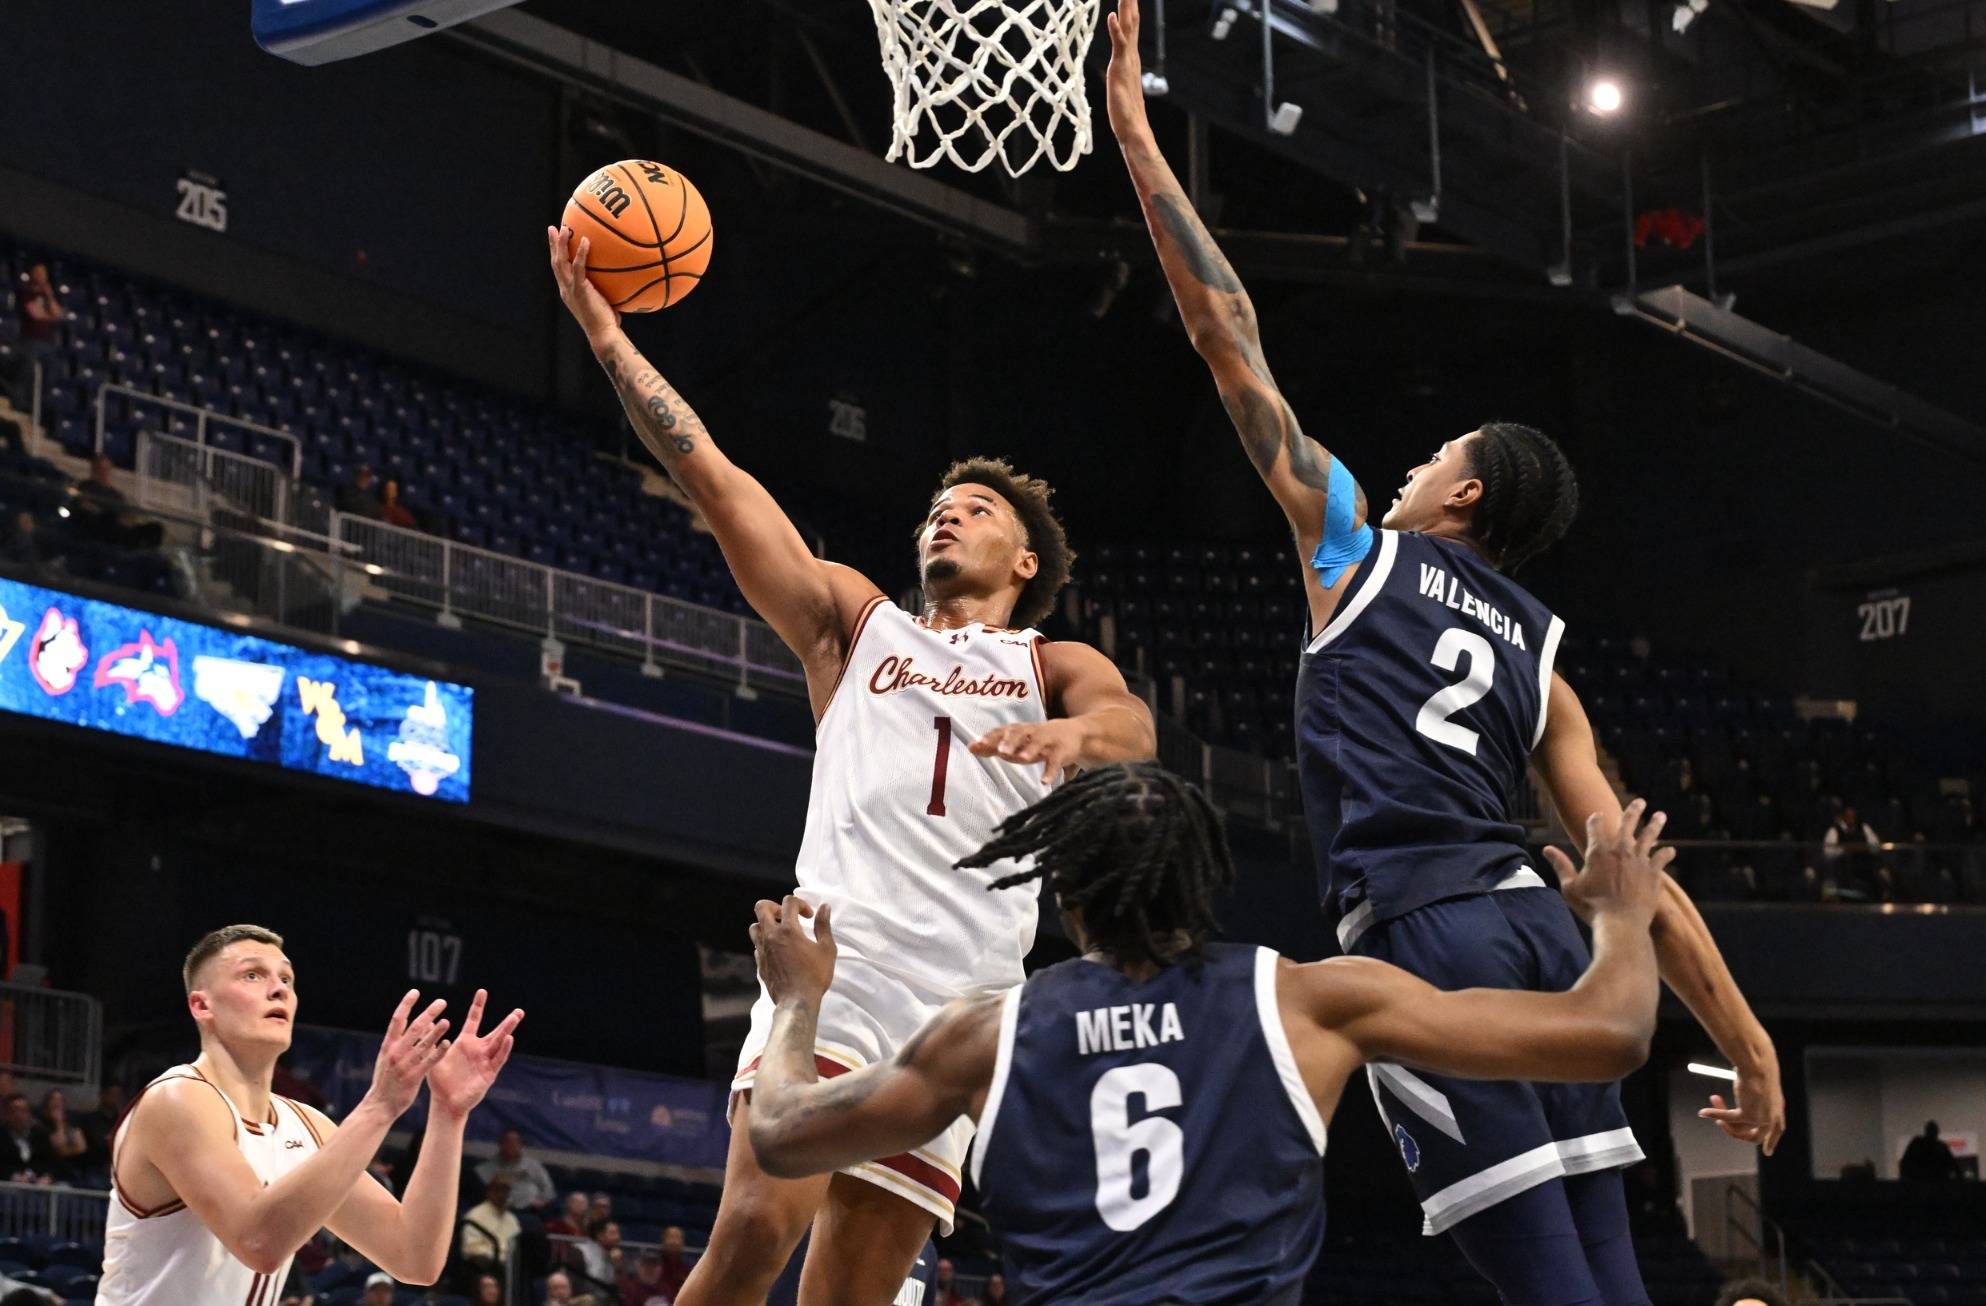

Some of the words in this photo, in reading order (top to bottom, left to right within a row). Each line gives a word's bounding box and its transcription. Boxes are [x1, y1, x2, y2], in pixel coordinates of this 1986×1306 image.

[176, 178, 228, 232] 205
[1419, 562, 1526, 651] VALENCIA
[1857, 596, 1911, 642] 207
[867, 654, 1030, 700] Charleston
[1416, 627, 1495, 756] 2
[926, 716, 951, 817] 1
[408, 929, 463, 986] 107
[1075, 1002, 1185, 1055] MEKA
[1090, 1062, 1184, 1232] 6
